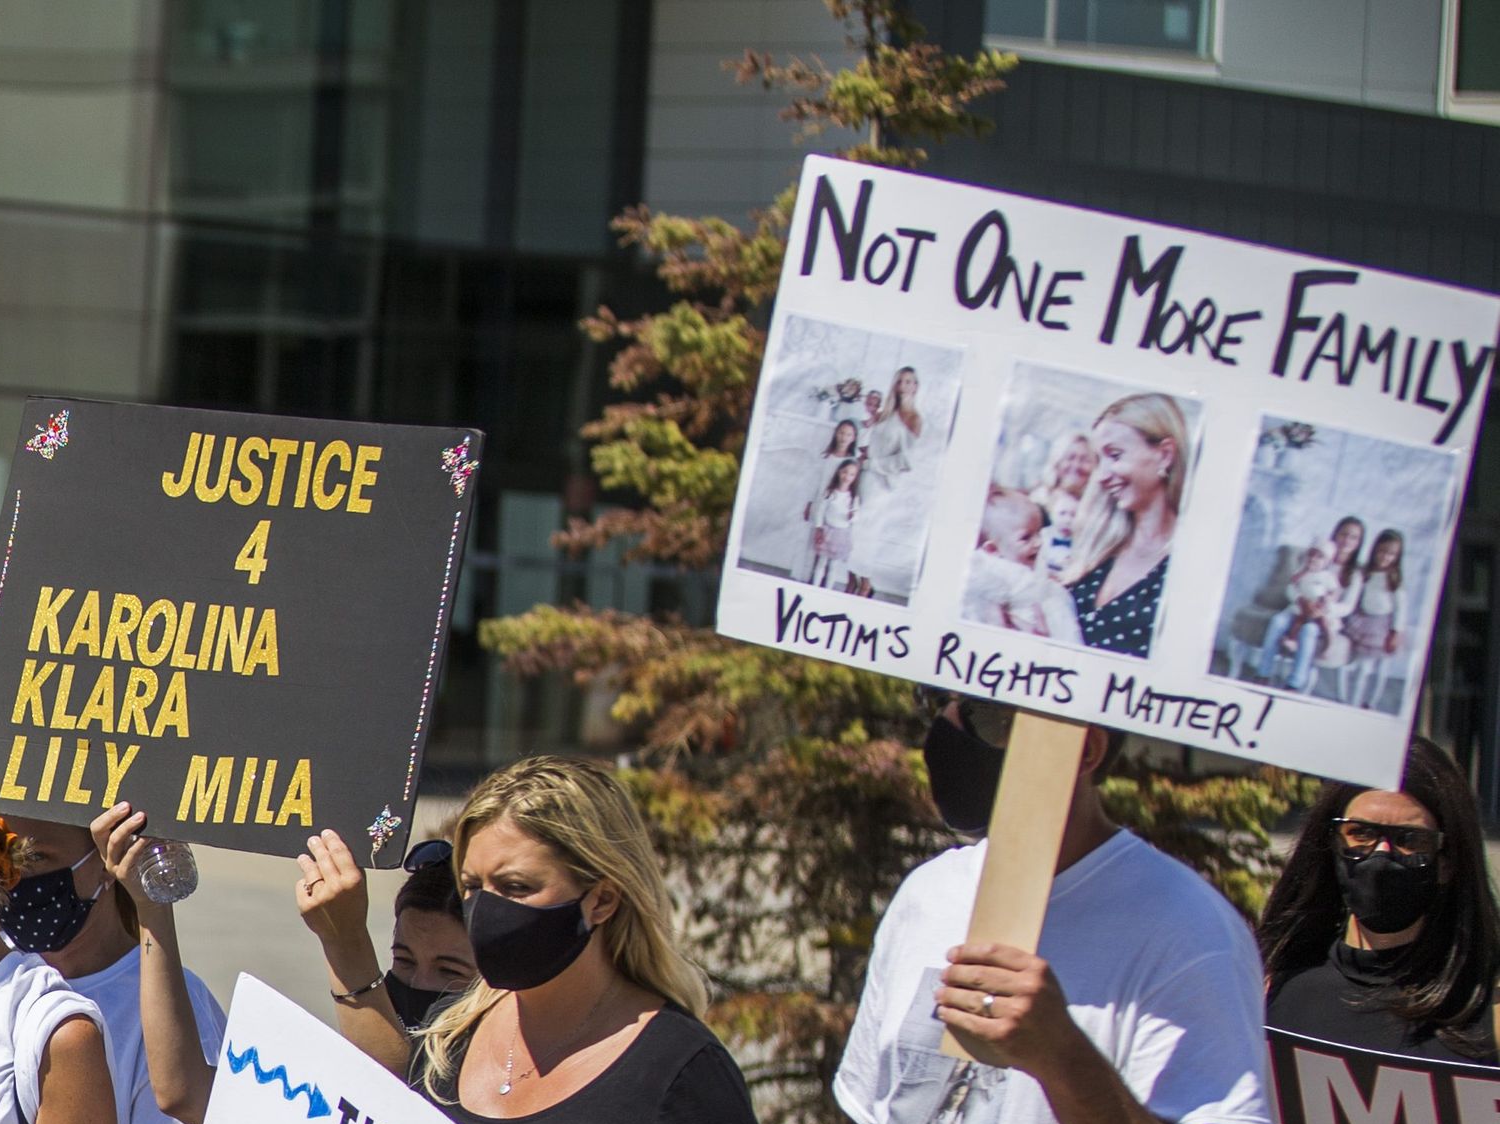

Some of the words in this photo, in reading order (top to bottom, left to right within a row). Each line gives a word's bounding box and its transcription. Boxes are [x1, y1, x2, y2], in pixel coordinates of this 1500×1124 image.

[800, 175, 936, 293] NOT
[954, 210, 1084, 331] ONE
[1100, 235, 1262, 366] MORE
[1271, 270, 1496, 445] FAMILY
[162, 432, 382, 514] JUSTICE
[234, 520, 271, 584] 4
[27, 586, 280, 676] KAROLINA
[775, 588, 910, 660] VICTIM'S
[935, 634, 1079, 704] RIGHTS
[1102, 672, 1273, 749] MATTER!
[11, 659, 190, 738] KLARA
[0, 735, 140, 809] LILY
[176, 755, 313, 827] MILA
